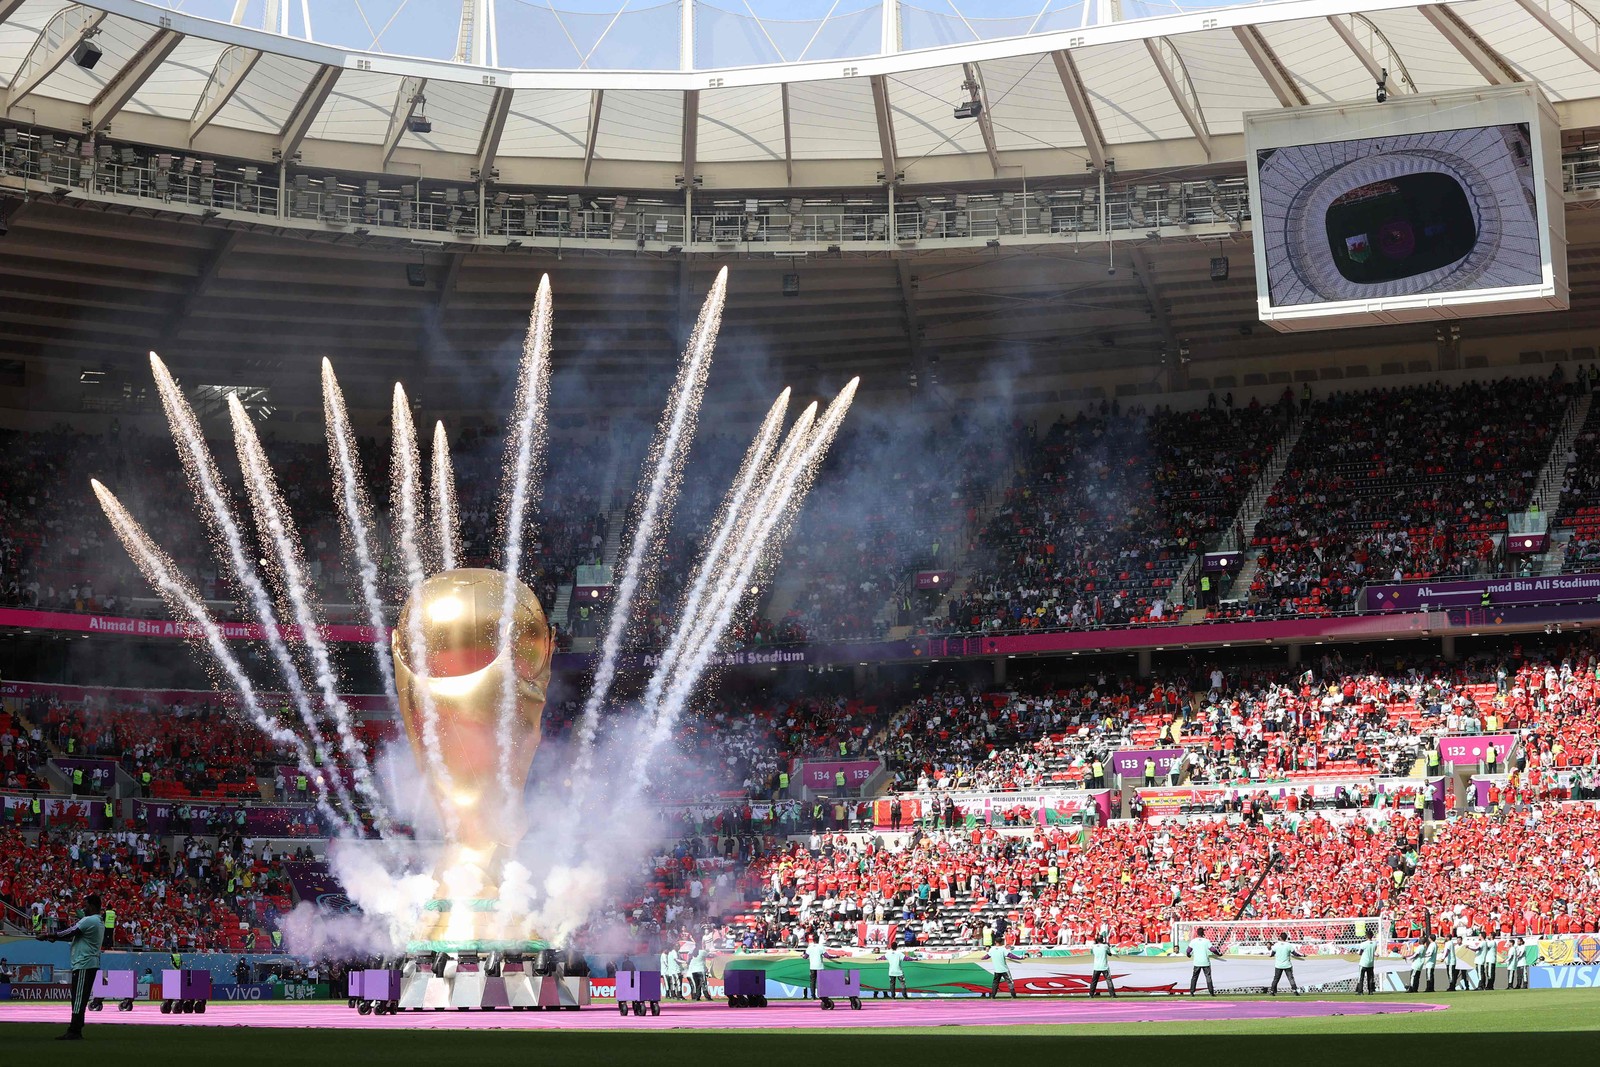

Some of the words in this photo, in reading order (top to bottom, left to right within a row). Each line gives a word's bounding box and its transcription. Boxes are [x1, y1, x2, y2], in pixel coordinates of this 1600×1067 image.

[1514, 581, 1533, 591] Bin
[1535, 579, 1550, 590] Ali
[1552, 577, 1600, 589] Stadium
[89, 617, 135, 632] Ahmad
[137, 622, 160, 634] Bin
[747, 651, 805, 665] Stadium
[1447, 746, 1466, 756] 132
[1493, 744, 1505, 755] 31
[1120, 759, 1138, 769] 133
[1159, 758, 1172, 768] 13
[813, 771, 830, 780] 134
[853, 769, 870, 779] 133
[44, 987, 72, 999] AIRWA
